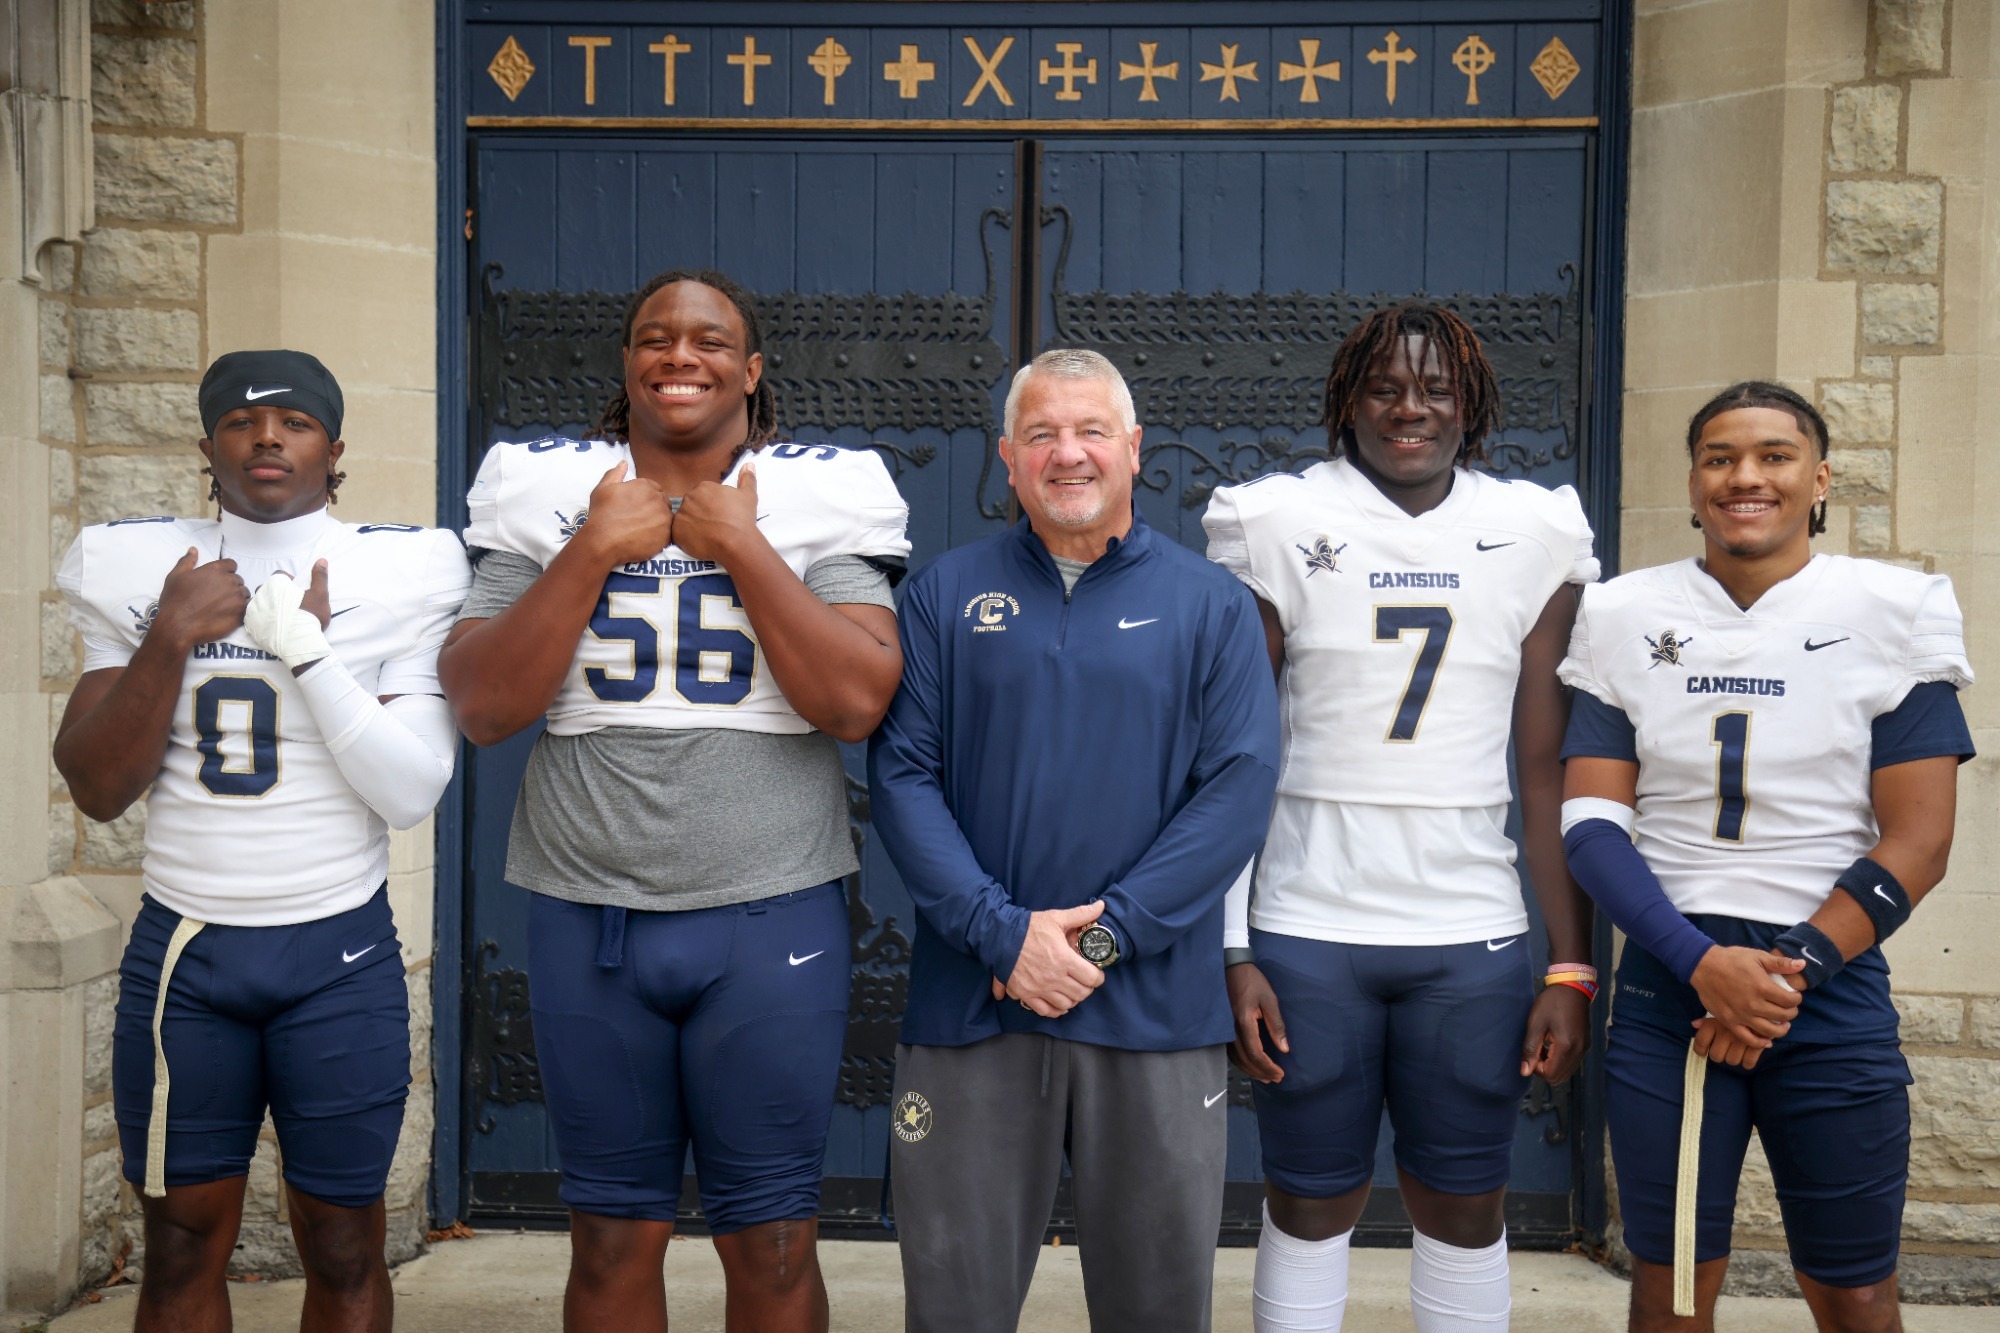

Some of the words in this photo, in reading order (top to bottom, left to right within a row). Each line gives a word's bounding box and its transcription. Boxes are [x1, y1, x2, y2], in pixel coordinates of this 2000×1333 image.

[624, 559, 717, 576] CANISIUS
[1369, 572, 1461, 589] CANISIUS
[979, 598, 1005, 624] C
[193, 642, 282, 661] CANISIU
[582, 573, 759, 709] 56
[1372, 603, 1457, 744] 7
[1686, 676, 1785, 697] CANISIUS
[191, 672, 282, 800] 0
[1709, 709, 1754, 844] 1
